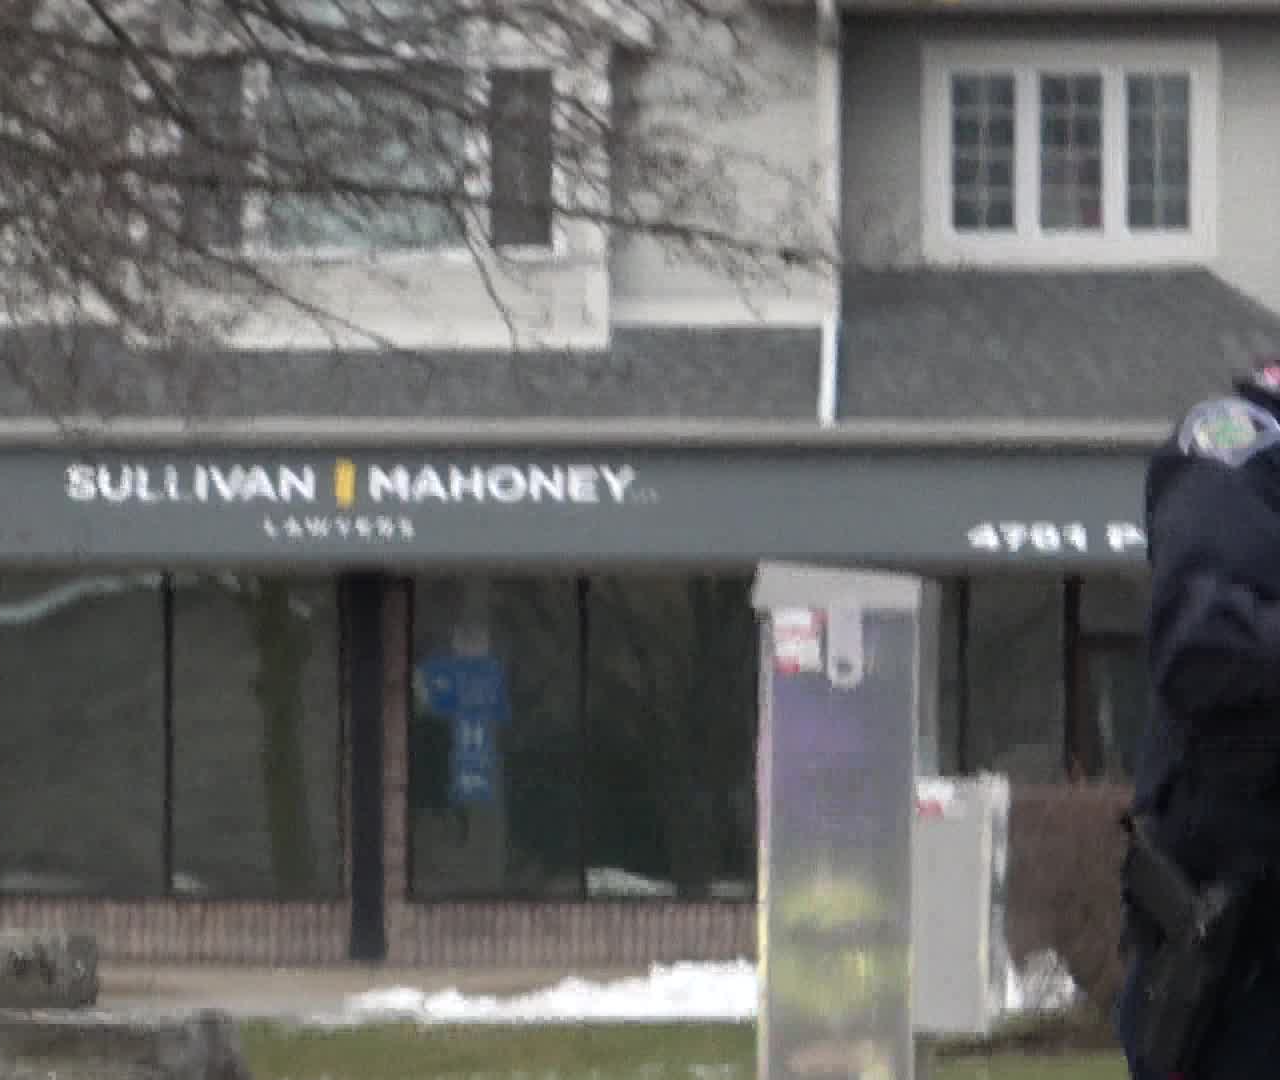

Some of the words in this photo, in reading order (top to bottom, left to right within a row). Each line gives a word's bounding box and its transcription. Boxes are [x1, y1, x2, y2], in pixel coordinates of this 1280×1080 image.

[66, 463, 317, 502] SULLIVAN
[368, 463, 637, 503] MAHONEY
[263, 516, 416, 541] LAWYERS
